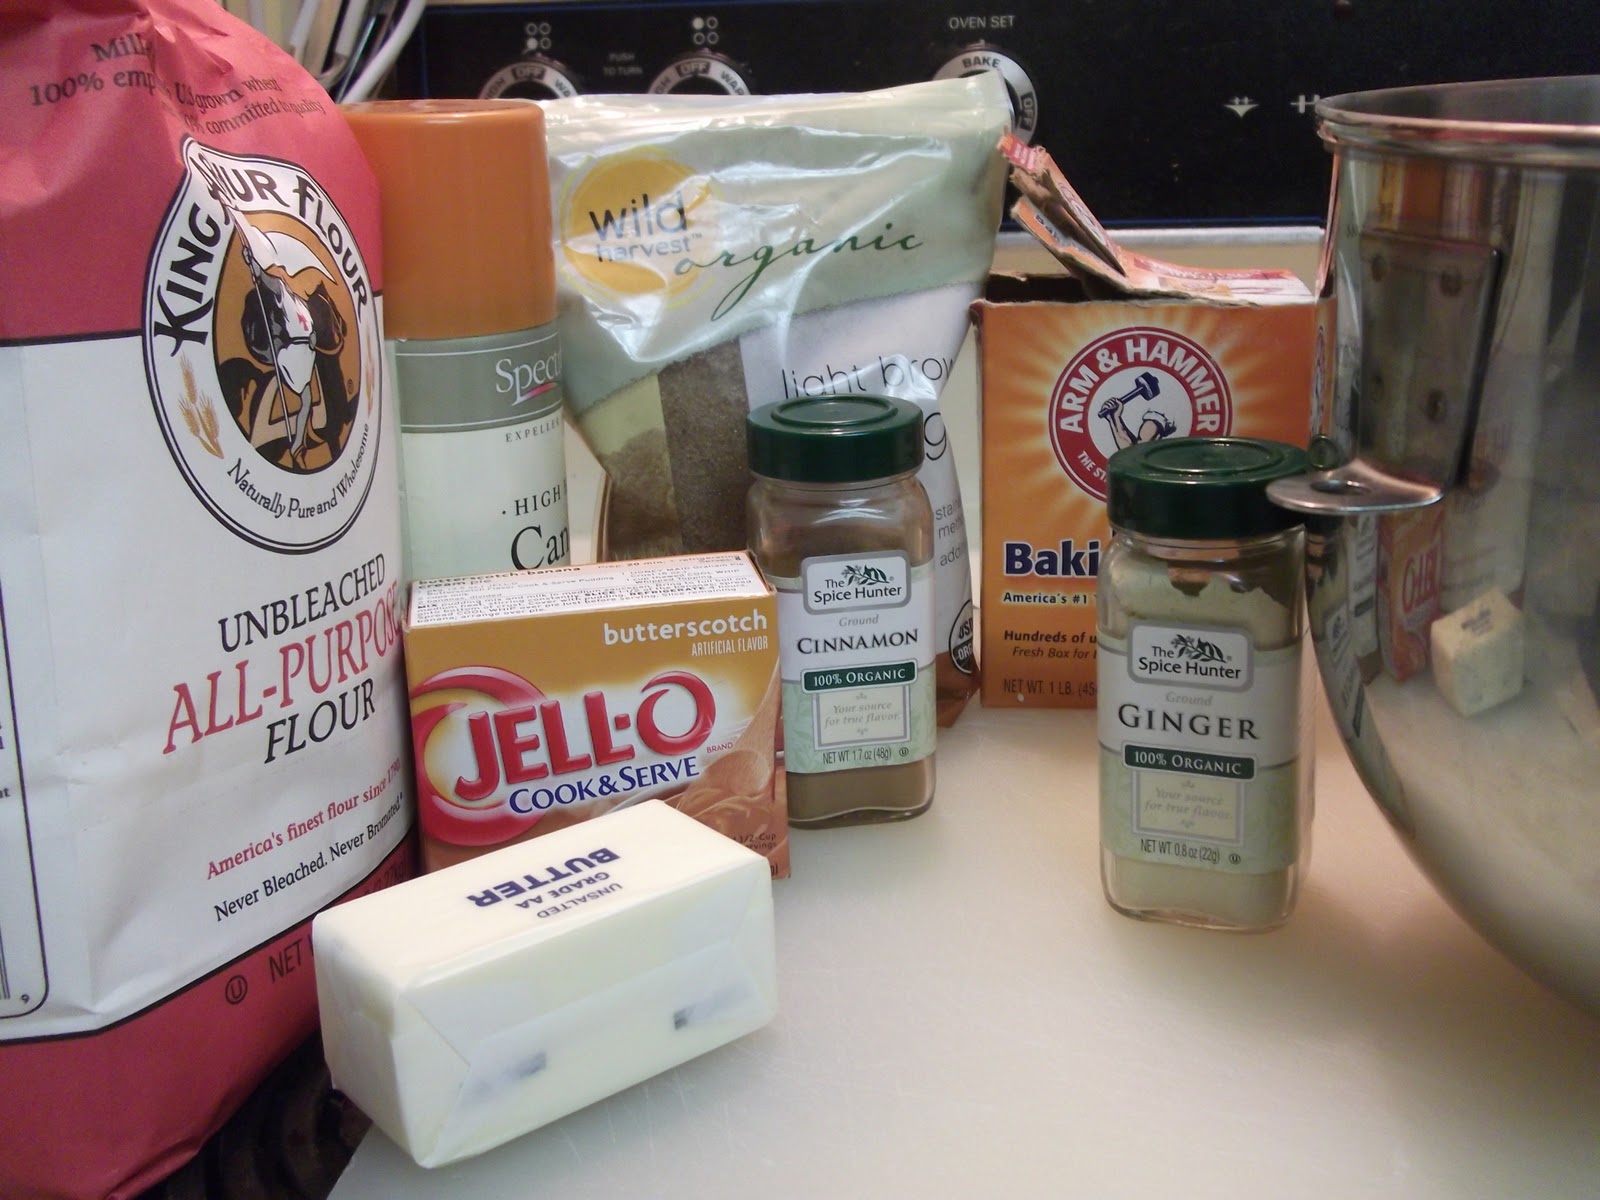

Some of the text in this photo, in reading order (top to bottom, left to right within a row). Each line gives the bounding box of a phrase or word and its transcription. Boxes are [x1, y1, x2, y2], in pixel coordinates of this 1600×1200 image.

[949, 15, 1016, 30] OVEN SET
[516, 66, 543, 79] OFF
[680, 61, 709, 74] OFF
[962, 56, 1001, 68] BAKE
[31, 72, 104, 106] 100%
[195, 87, 244, 114] grown
[241, 75, 282, 92] wheat
[206, 96, 281, 134] committed
[288, 99, 326, 119] quality
[1021, 97, 1034, 131] OFF
[588, 190, 688, 242] wild
[596, 235, 691, 262] harvest
[154, 202, 222, 357] KING
[293, 174, 369, 322] FLOUR
[674, 223, 924, 321] organic
[782, 364, 866, 399] light
[1060, 337, 1221, 433] ARM & HAMMER
[227, 423, 369, 519] Naturally Pure and Wholesome
[1078, 450, 1096, 471] THE
[514, 484, 561, 516] HIGH
[511, 525, 569, 571] Can
[1004, 540, 1100, 577] Baki
[418, 566, 581, 585] butterscotch-banana
[418, 581, 466, 589] cream
[825, 578, 844, 588] The
[218, 553, 385, 652] UNBLEACHED
[628, 586, 704, 596] REFRIGERATE
[814, 585, 902, 605] Spice Hunter
[1003, 591, 1088, 605] America's #1
[603, 609, 767, 645] butterscotch
[839, 614, 879, 627] Ground
[691, 635, 768, 657] ARTIFICIAL FLAVOR
[797, 629, 919, 655] CINNAMON
[1004, 630, 1067, 643] Hundreds
[1071, 631, 1087, 643] of
[1012, 646, 1089, 660] Fresh Box for
[1152, 645, 1175, 658] The
[163, 580, 401, 754] ALL-PURPOSE
[813, 668, 906, 687] 100% ORGANIC
[1138, 657, 1241, 680] Spice Hunter
[1004, 678, 1023, 694] NET
[1049, 681, 1054, 694] 1
[1165, 691, 1213, 705] Ground
[264, 678, 375, 764] FLOUR
[833, 702, 892, 714] Your source
[824, 716, 840, 729] for
[843, 716, 863, 725] true
[1118, 703, 1260, 740] GINGER
[706, 741, 734, 753] BRAND
[823, 752, 836, 764] NET
[853, 748, 862, 761] 1.7
[864, 751, 872, 760] oz
[874, 746, 892, 761] (48g)
[1135, 750, 1242, 775] 100% ORGANIC
[509, 755, 699, 814] COOK&SERVE
[1156, 787, 1181, 799] Your
[1144, 800, 1162, 812] for
[207, 832, 283, 880] America's
[287, 811, 324, 841] finest
[327, 794, 359, 820] flour
[362, 777, 387, 803] since
[1141, 838, 1156, 853] NET
[1174, 843, 1187, 857] 0.8
[1188, 848, 1198, 858] oz
[1199, 846, 1220, 865] (22g)
[214, 888, 259, 922] Never
[263, 852, 328, 897] Bleached.
[329, 831, 365, 861] Never
[466, 847, 621, 907] BUTTER
[515, 872, 610, 909] GRADE AA
[537, 882, 623, 918] UNSALTED
[269, 938, 303, 982] NET
